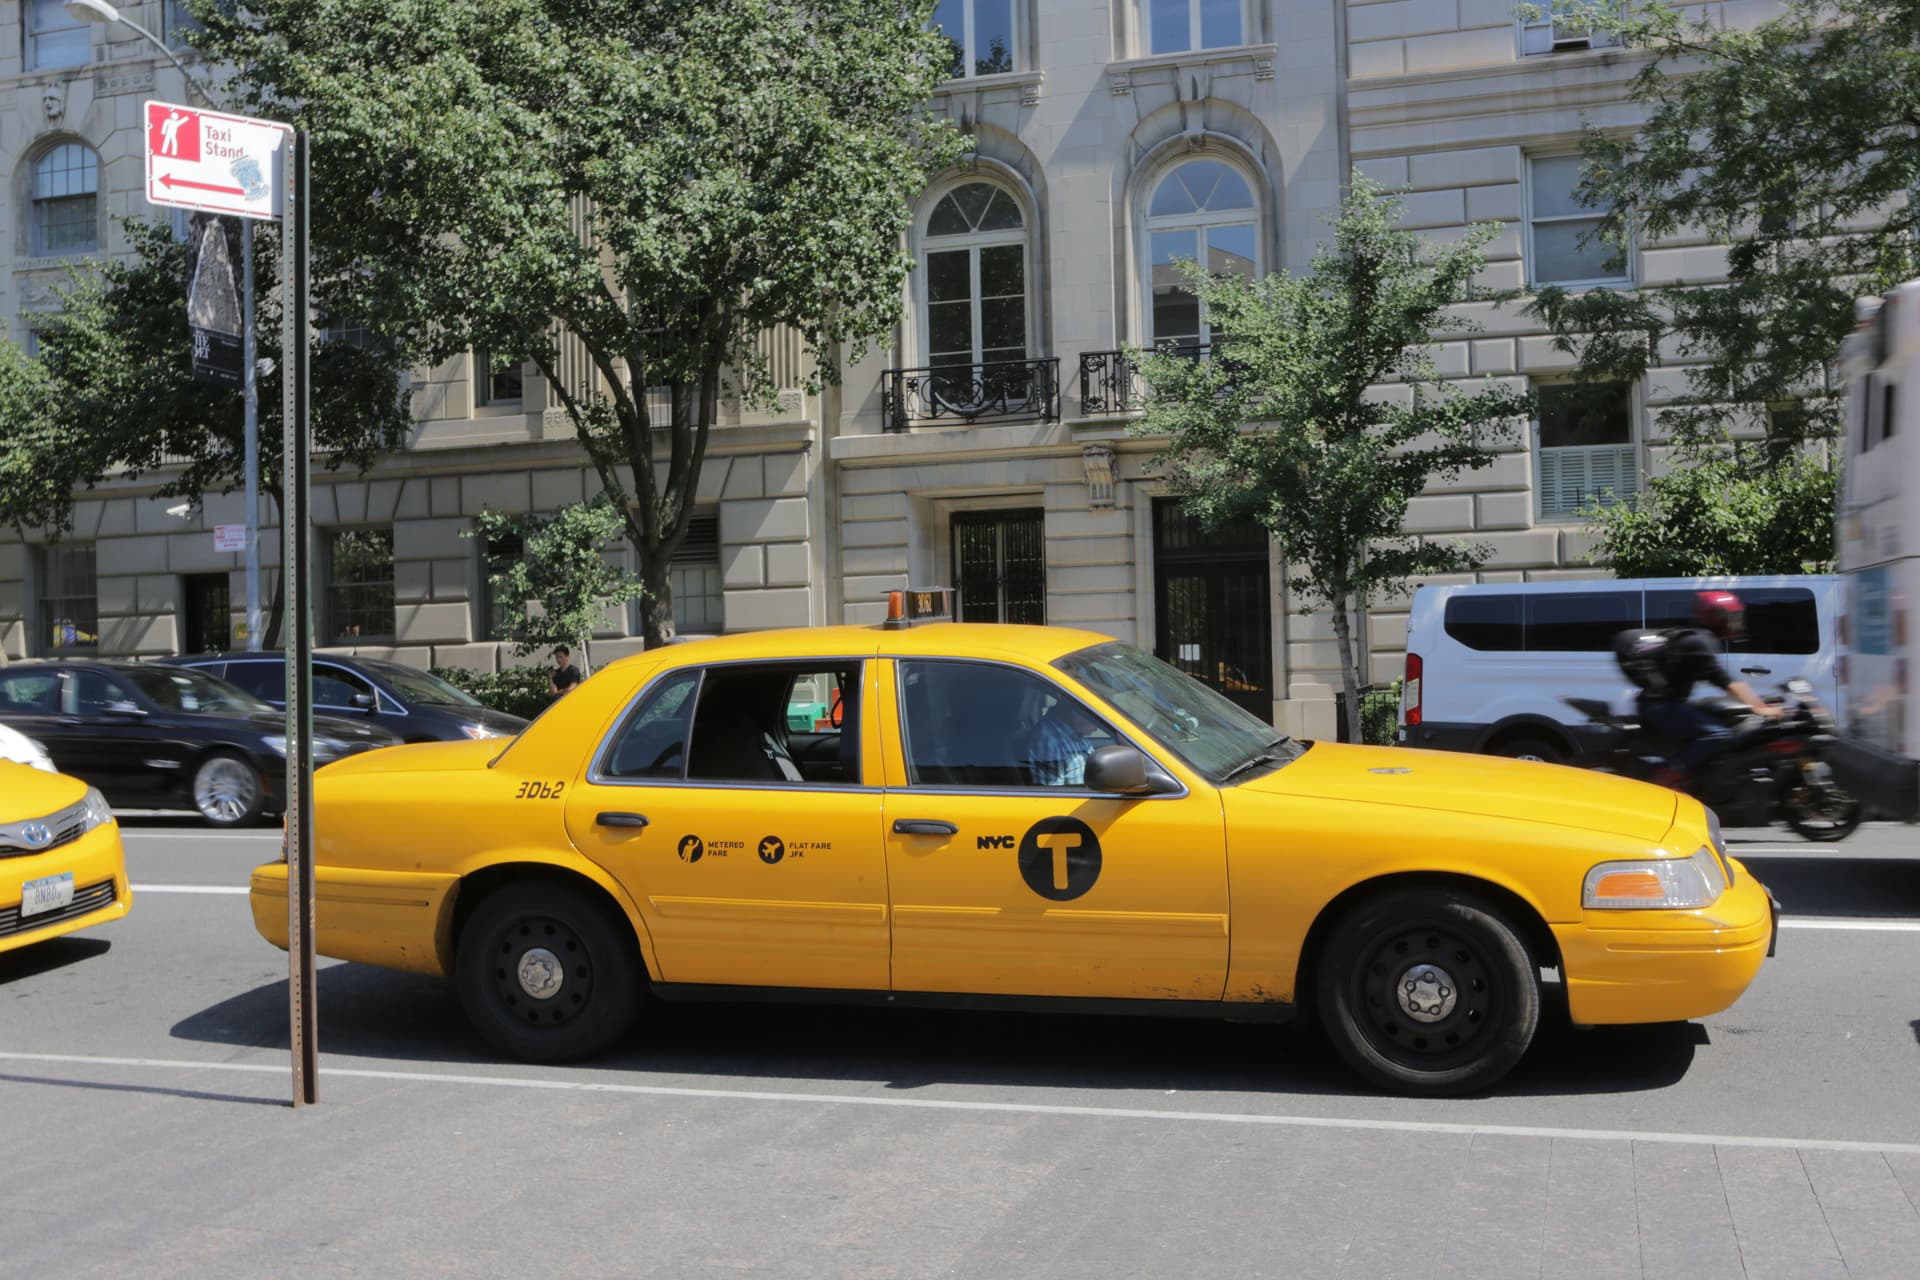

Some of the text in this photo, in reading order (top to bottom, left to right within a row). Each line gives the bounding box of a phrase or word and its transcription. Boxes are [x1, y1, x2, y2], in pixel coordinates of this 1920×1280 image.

[205, 125, 232, 142] Taxi
[205, 141, 244, 158] Stand
[708, 841, 744, 849] METERED
[789, 842, 832, 850] FLAT FARE
[789, 850, 804, 858] JFK
[977, 833, 1082, 890] NYC T
